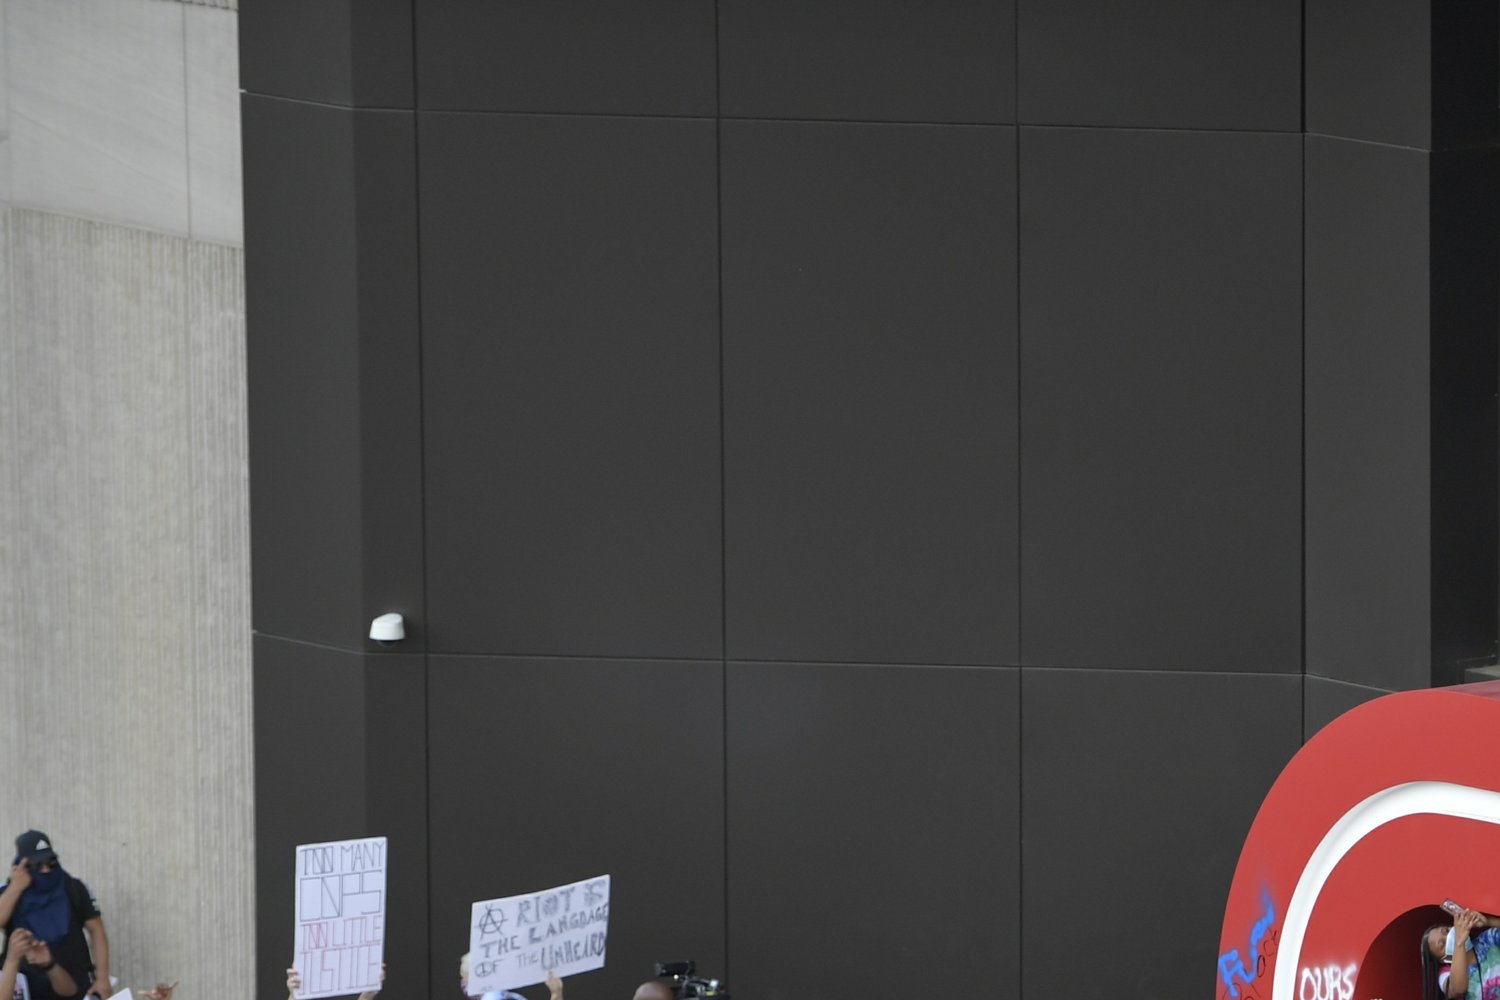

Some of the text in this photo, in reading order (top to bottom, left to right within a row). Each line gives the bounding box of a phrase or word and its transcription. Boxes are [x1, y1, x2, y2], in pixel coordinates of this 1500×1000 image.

[340, 841, 385, 871] MANY
[516, 886, 576, 927] RIOT
[333, 915, 383, 947] LITTLE
[480, 935, 521, 959] THE
[517, 953, 539, 969] THE
[299, 943, 382, 995] JUSTICE
